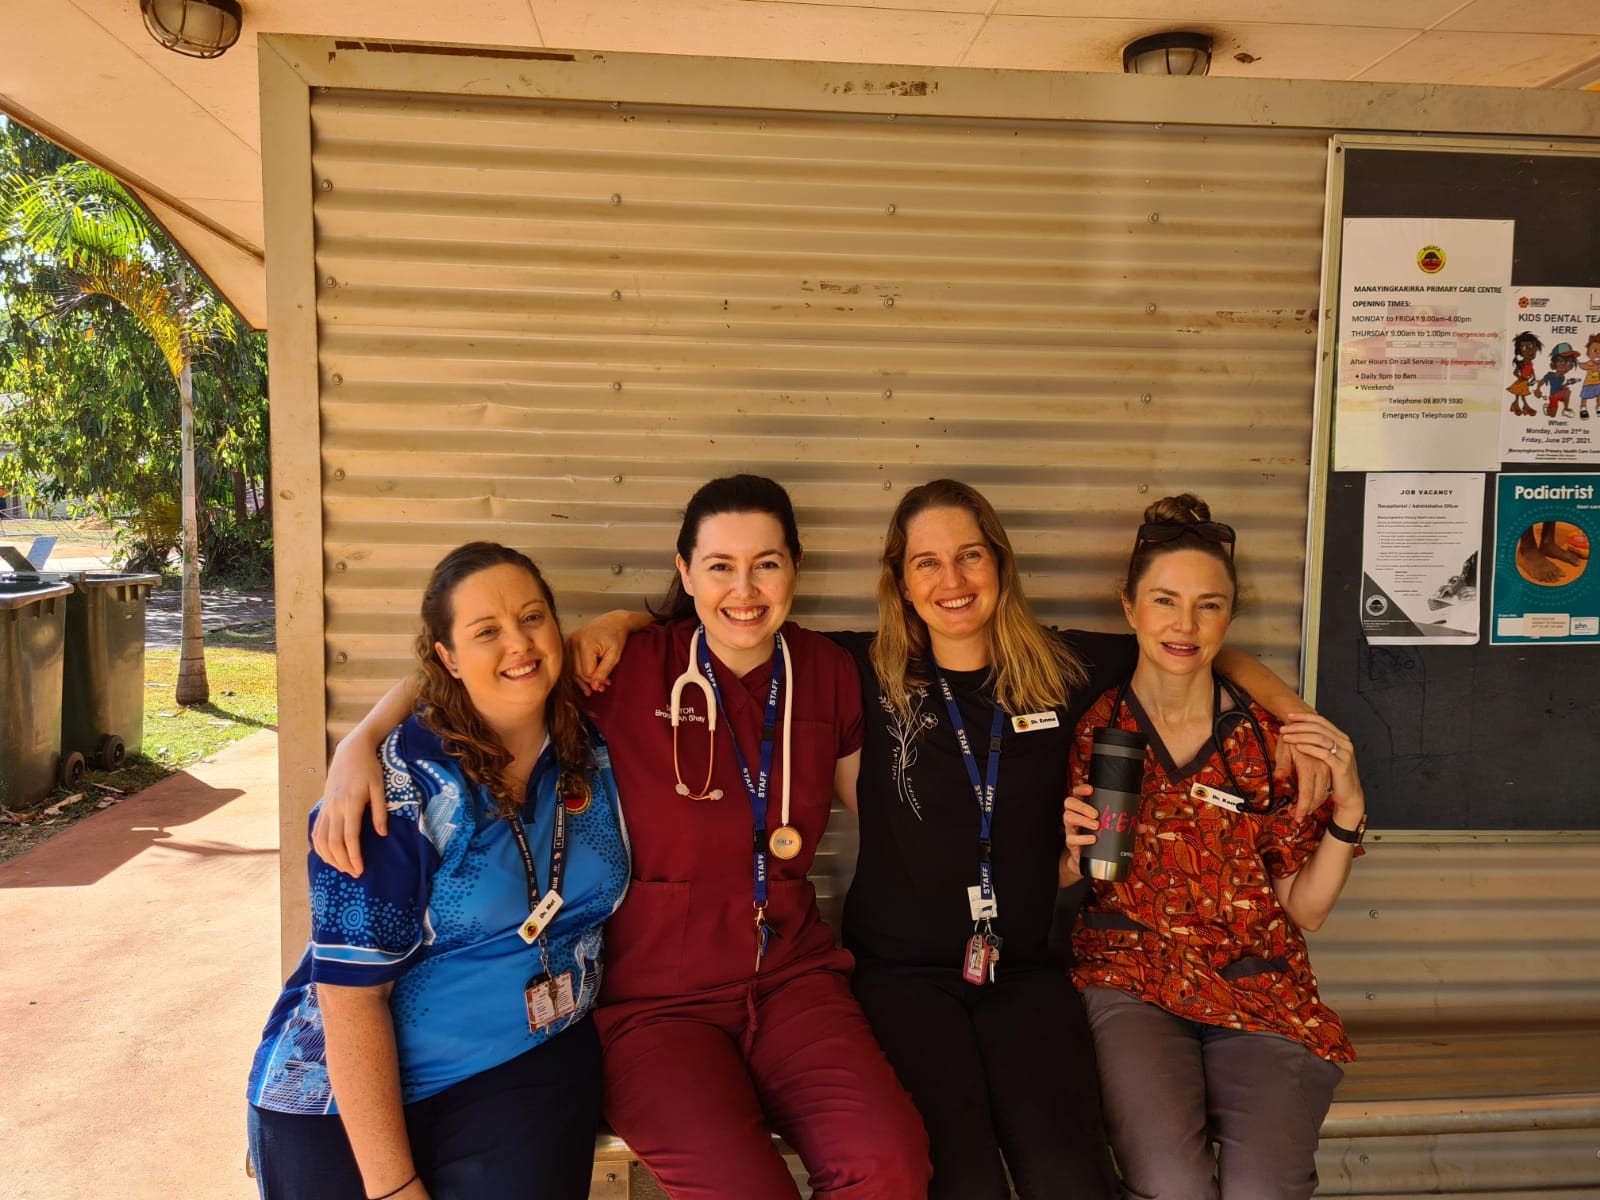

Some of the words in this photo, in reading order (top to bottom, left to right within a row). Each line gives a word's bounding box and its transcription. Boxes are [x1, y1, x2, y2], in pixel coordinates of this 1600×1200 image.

[1354, 285, 1425, 293] MANAYINGKARIRRA
[1426, 285, 1458, 293] PRIMARY
[1477, 286, 1503, 294] CENTRE
[1518, 313, 1541, 322] KIDS
[1544, 313, 1582, 323] DENTAL
[1551, 325, 1578, 334] HERE
[1389, 397, 1422, 405] Telephone
[1382, 411, 1420, 420] Emergency
[1421, 411, 1455, 419] Telephone
[1514, 484, 1594, 500] Podiatrist
[704, 662, 717, 688] STAFF
[768, 678, 779, 706] STAFF
[957, 729, 971, 755] STAFF
[742, 767, 757, 794] STAFF
[757, 770, 768, 799] STAFF
[984, 784, 995, 812] STAFF
[757, 854, 766, 882] STAFF
[982, 866, 991, 894] STAFF
[545, 899, 556, 910] Mel
